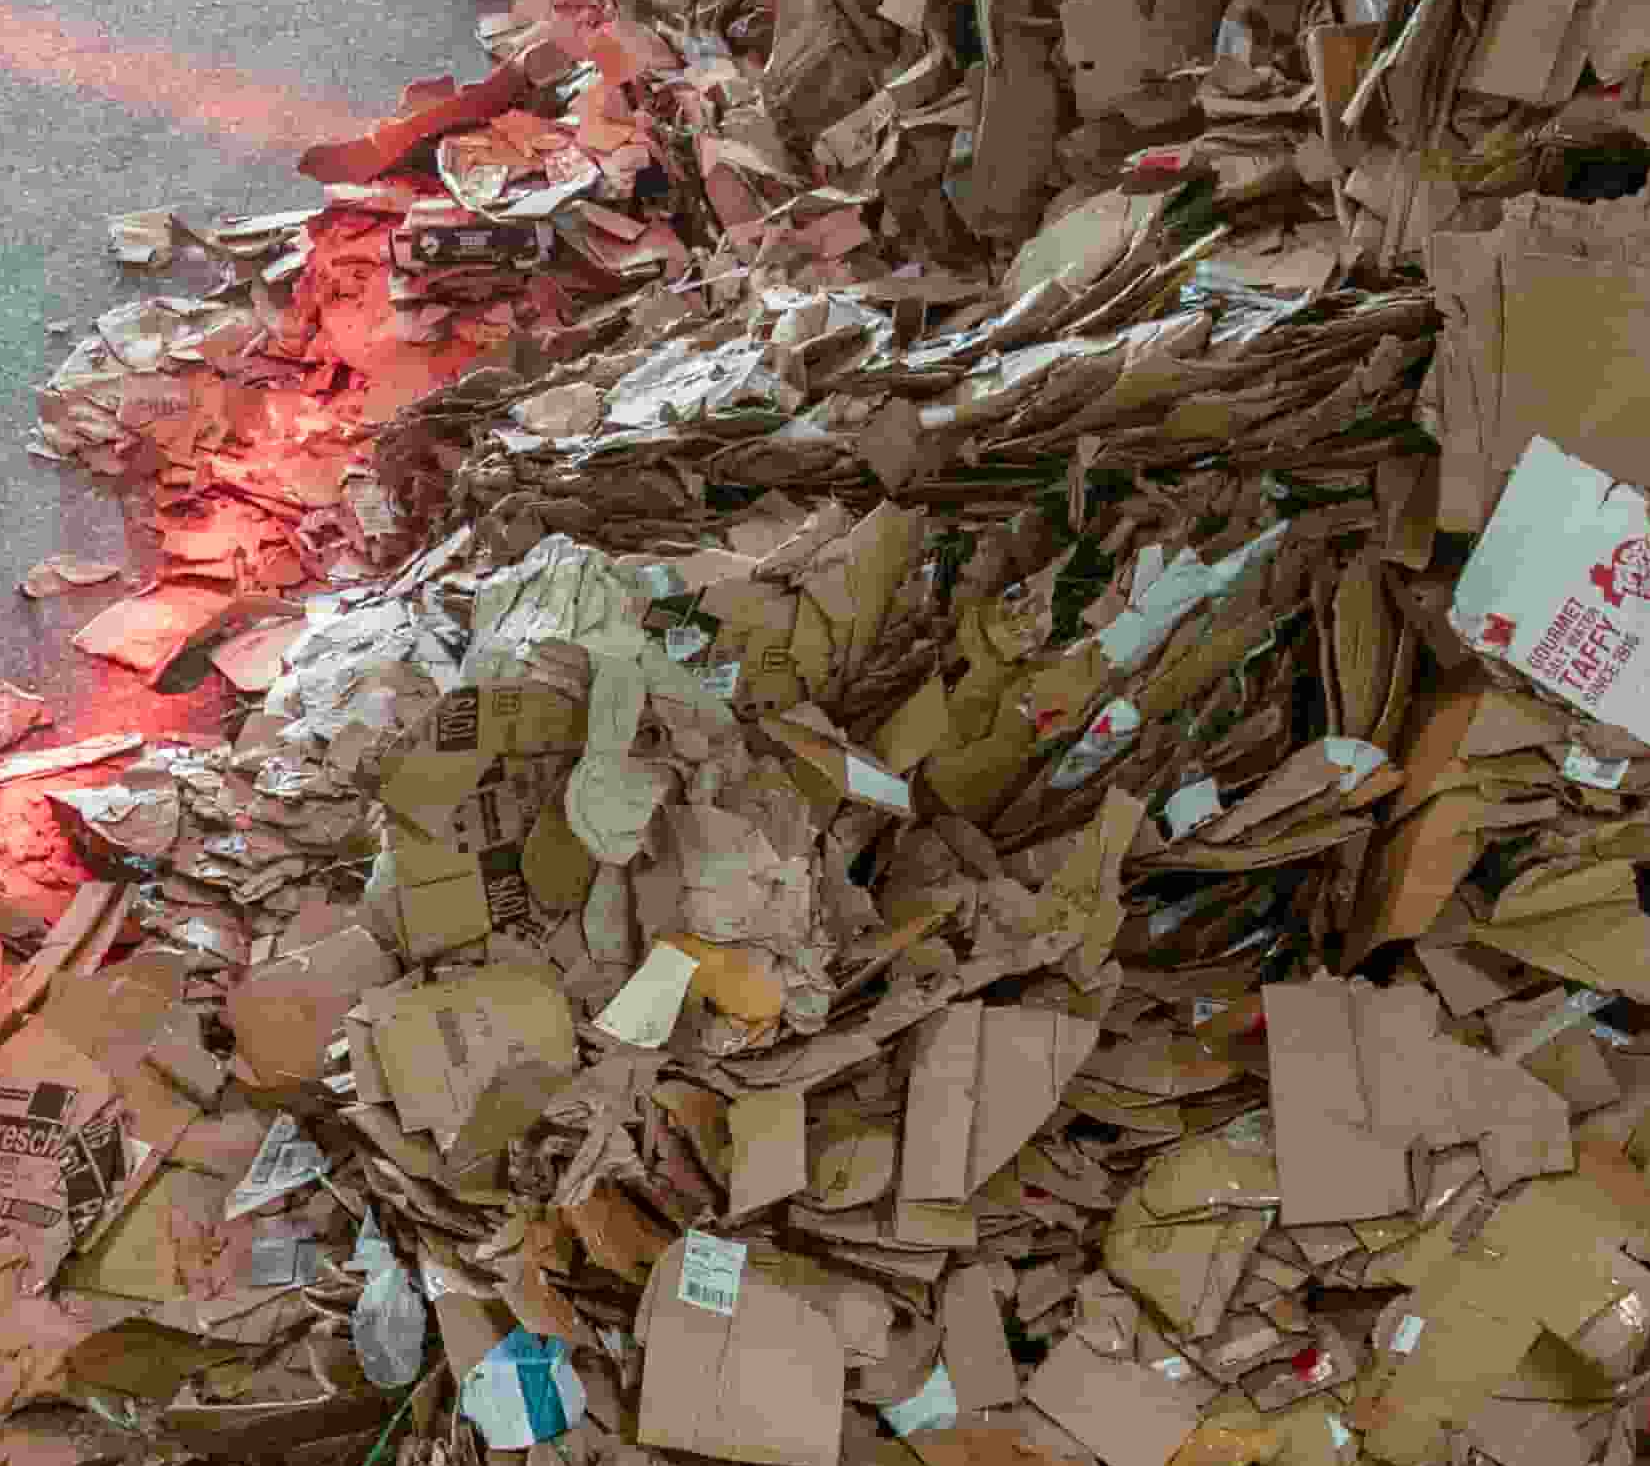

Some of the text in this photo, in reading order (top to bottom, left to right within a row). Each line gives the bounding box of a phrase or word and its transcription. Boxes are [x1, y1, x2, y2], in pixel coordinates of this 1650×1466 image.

[1525, 594, 1585, 671] GOURMET
[1557, 613, 1623, 693] TAFFY
[1581, 660, 1620, 707] SINCE
